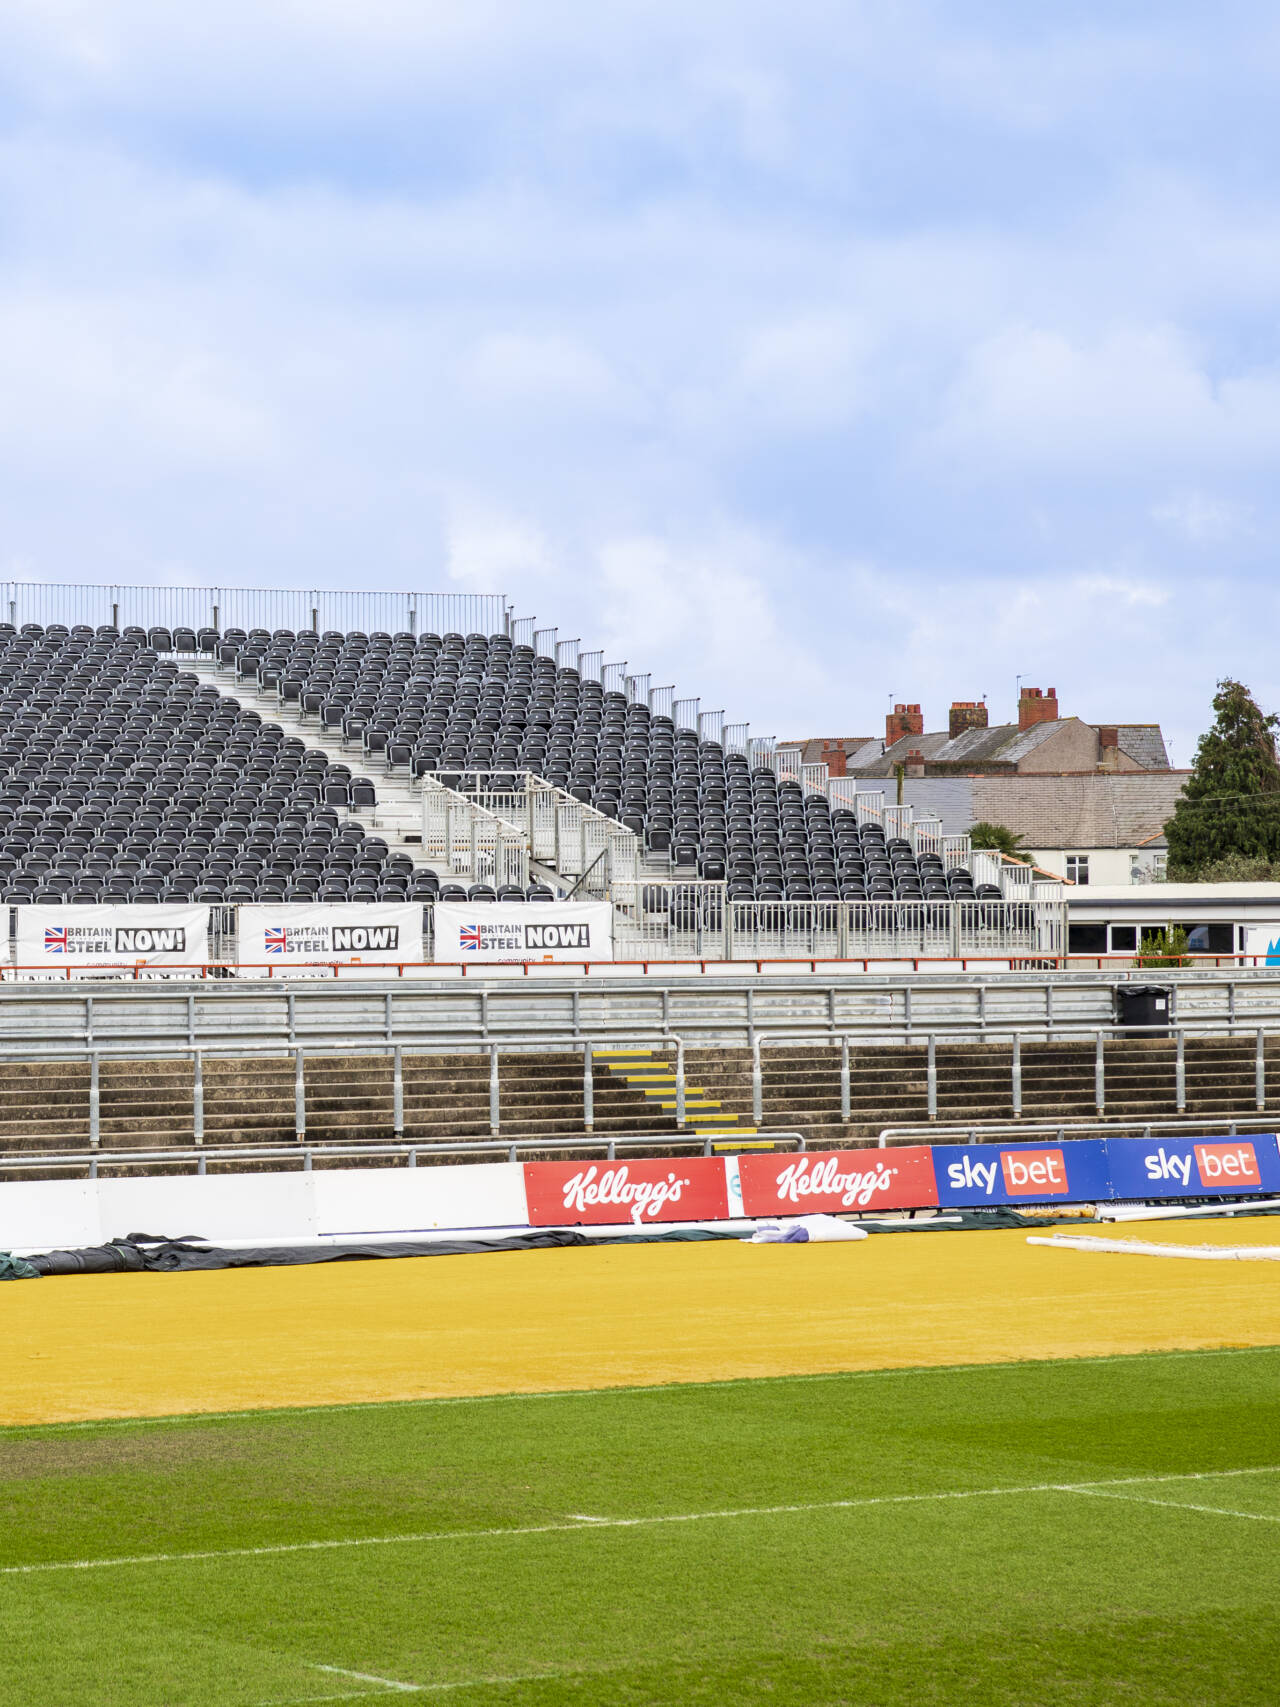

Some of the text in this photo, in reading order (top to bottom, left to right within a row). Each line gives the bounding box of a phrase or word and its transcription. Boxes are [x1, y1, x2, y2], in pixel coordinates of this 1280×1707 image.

[67, 927, 112, 937] BRITAIN
[67, 929, 184, 953] STEEL NOW!
[286, 927, 329, 937] BRITAIN
[286, 928, 397, 953] STEEL NOW!
[480, 925, 521, 934] BRITAIN
[480, 926, 587, 950] STEEL NOW!
[948, 1155, 1062, 1195] sky bet
[1144, 1148, 1254, 1186] sky bet
[563, 1166, 683, 1216] Kellogg's
[776, 1157, 893, 1205] Kellogg's
